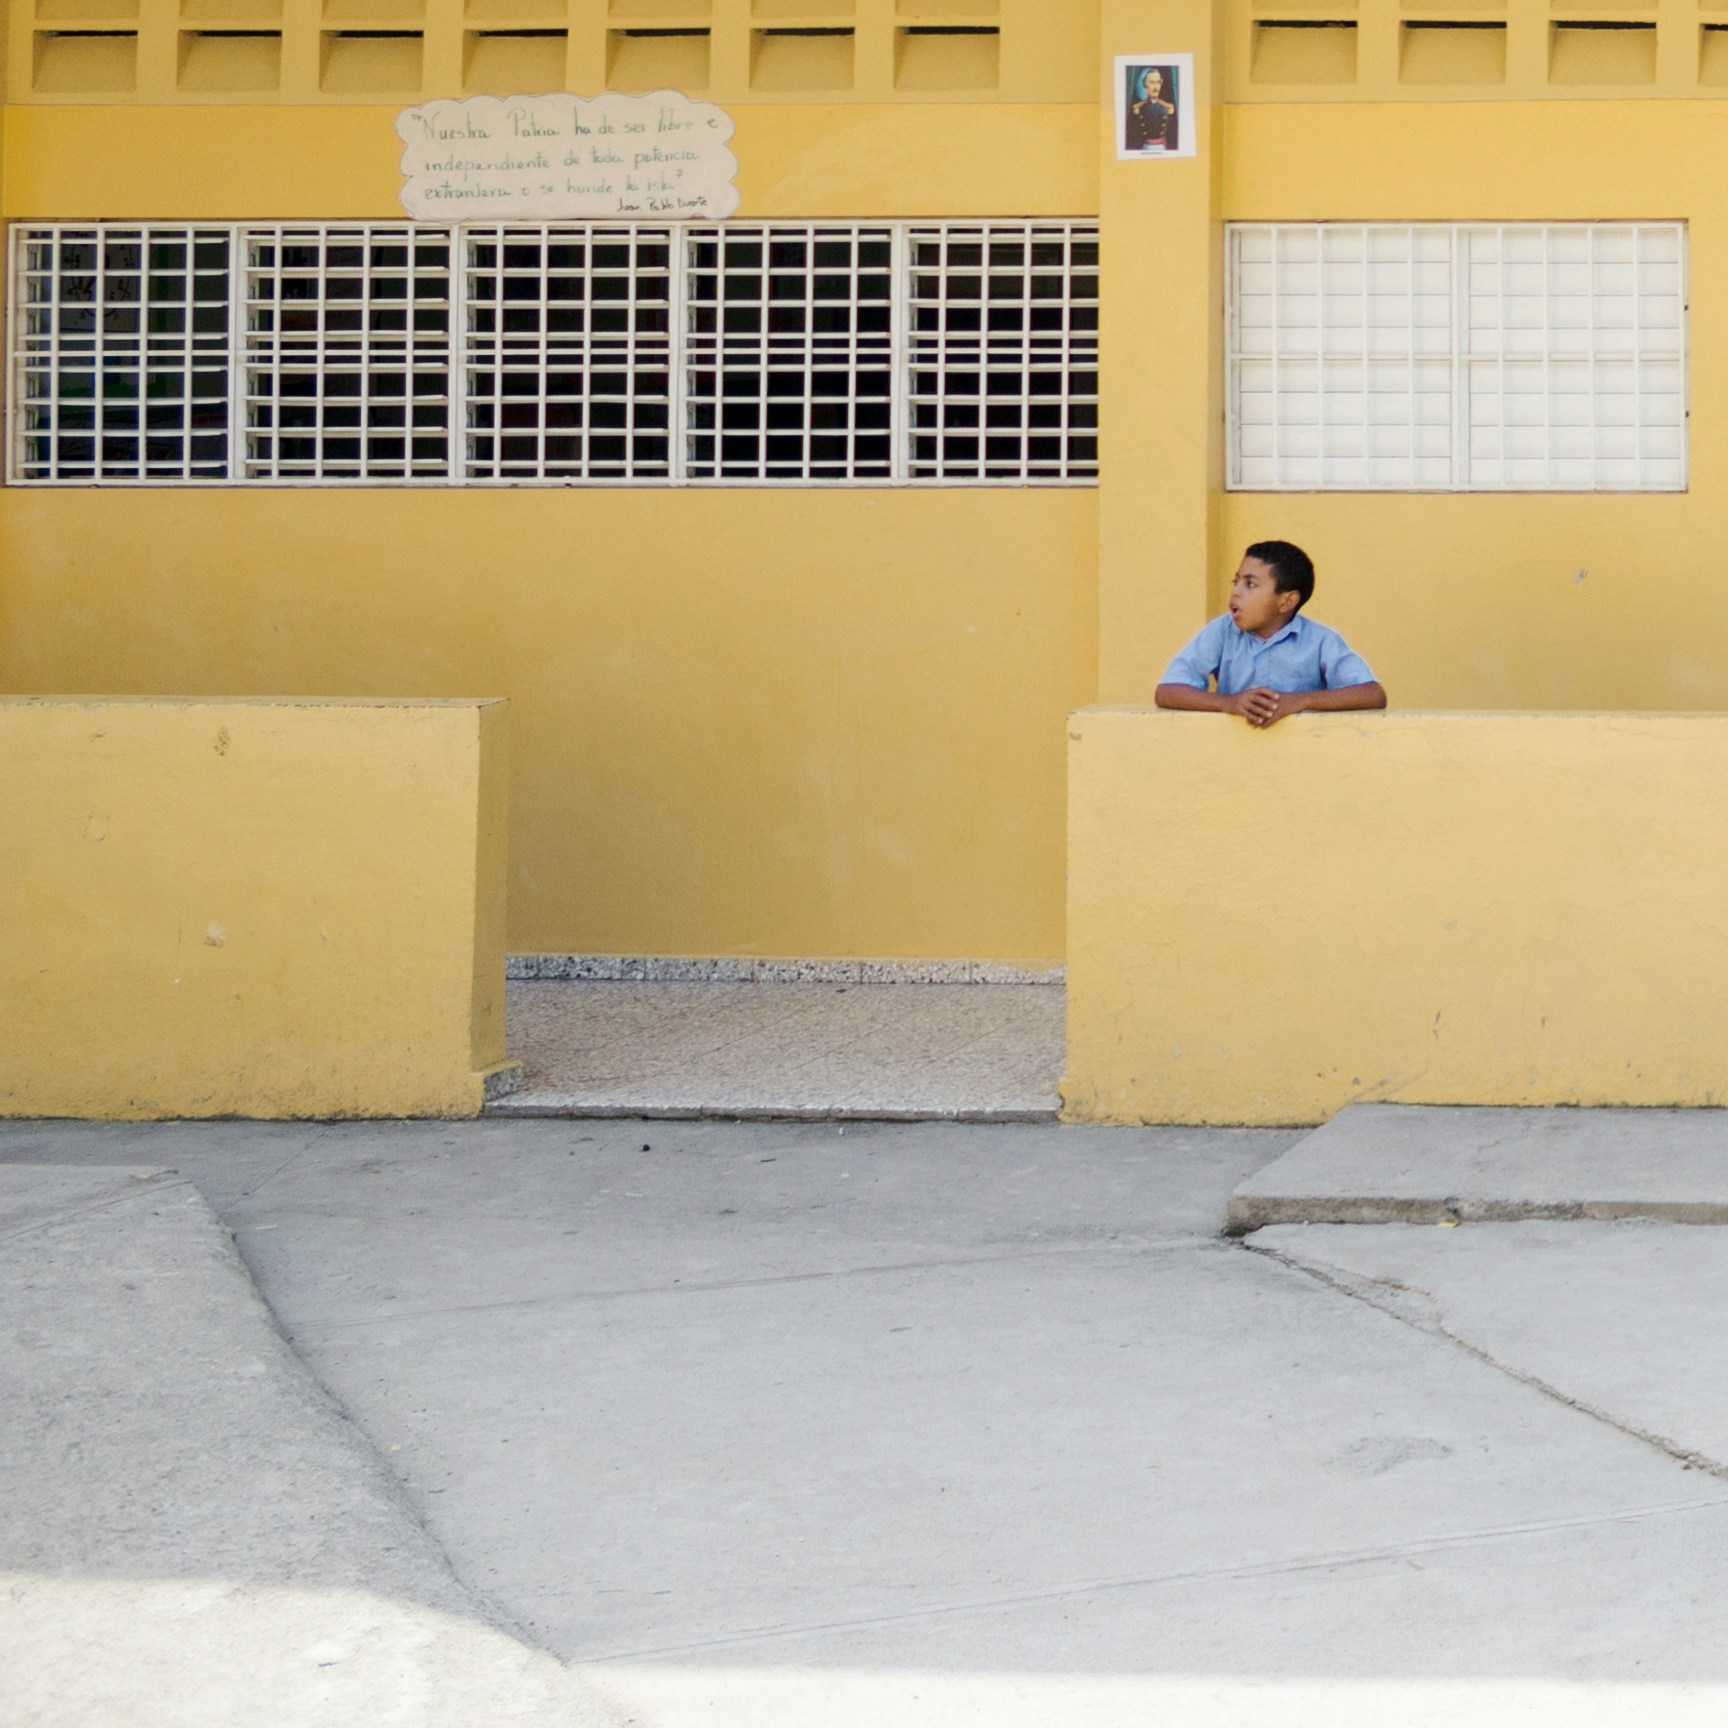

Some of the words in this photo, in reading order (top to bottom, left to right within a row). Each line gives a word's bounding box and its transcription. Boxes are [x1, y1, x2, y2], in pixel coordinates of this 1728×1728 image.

[506, 106, 560, 138] Patria
[573, 105, 593, 136] ha
[598, 114, 617, 135] de
[623, 122, 647, 134] ser
[657, 106, 695, 133] libre
[706, 117, 719, 129] e
[424, 150, 553, 183] independiente
[563, 149, 582, 167] de
[590, 144, 625, 164] toda
[634, 144, 701, 171] potencia
[521, 185, 531, 197] o
[538, 183, 556, 195] se
[566, 176, 614, 194] hunde
[625, 173, 640, 192] la
[645, 196, 675, 212] Pablo
[676, 195, 708, 209] Duarte
